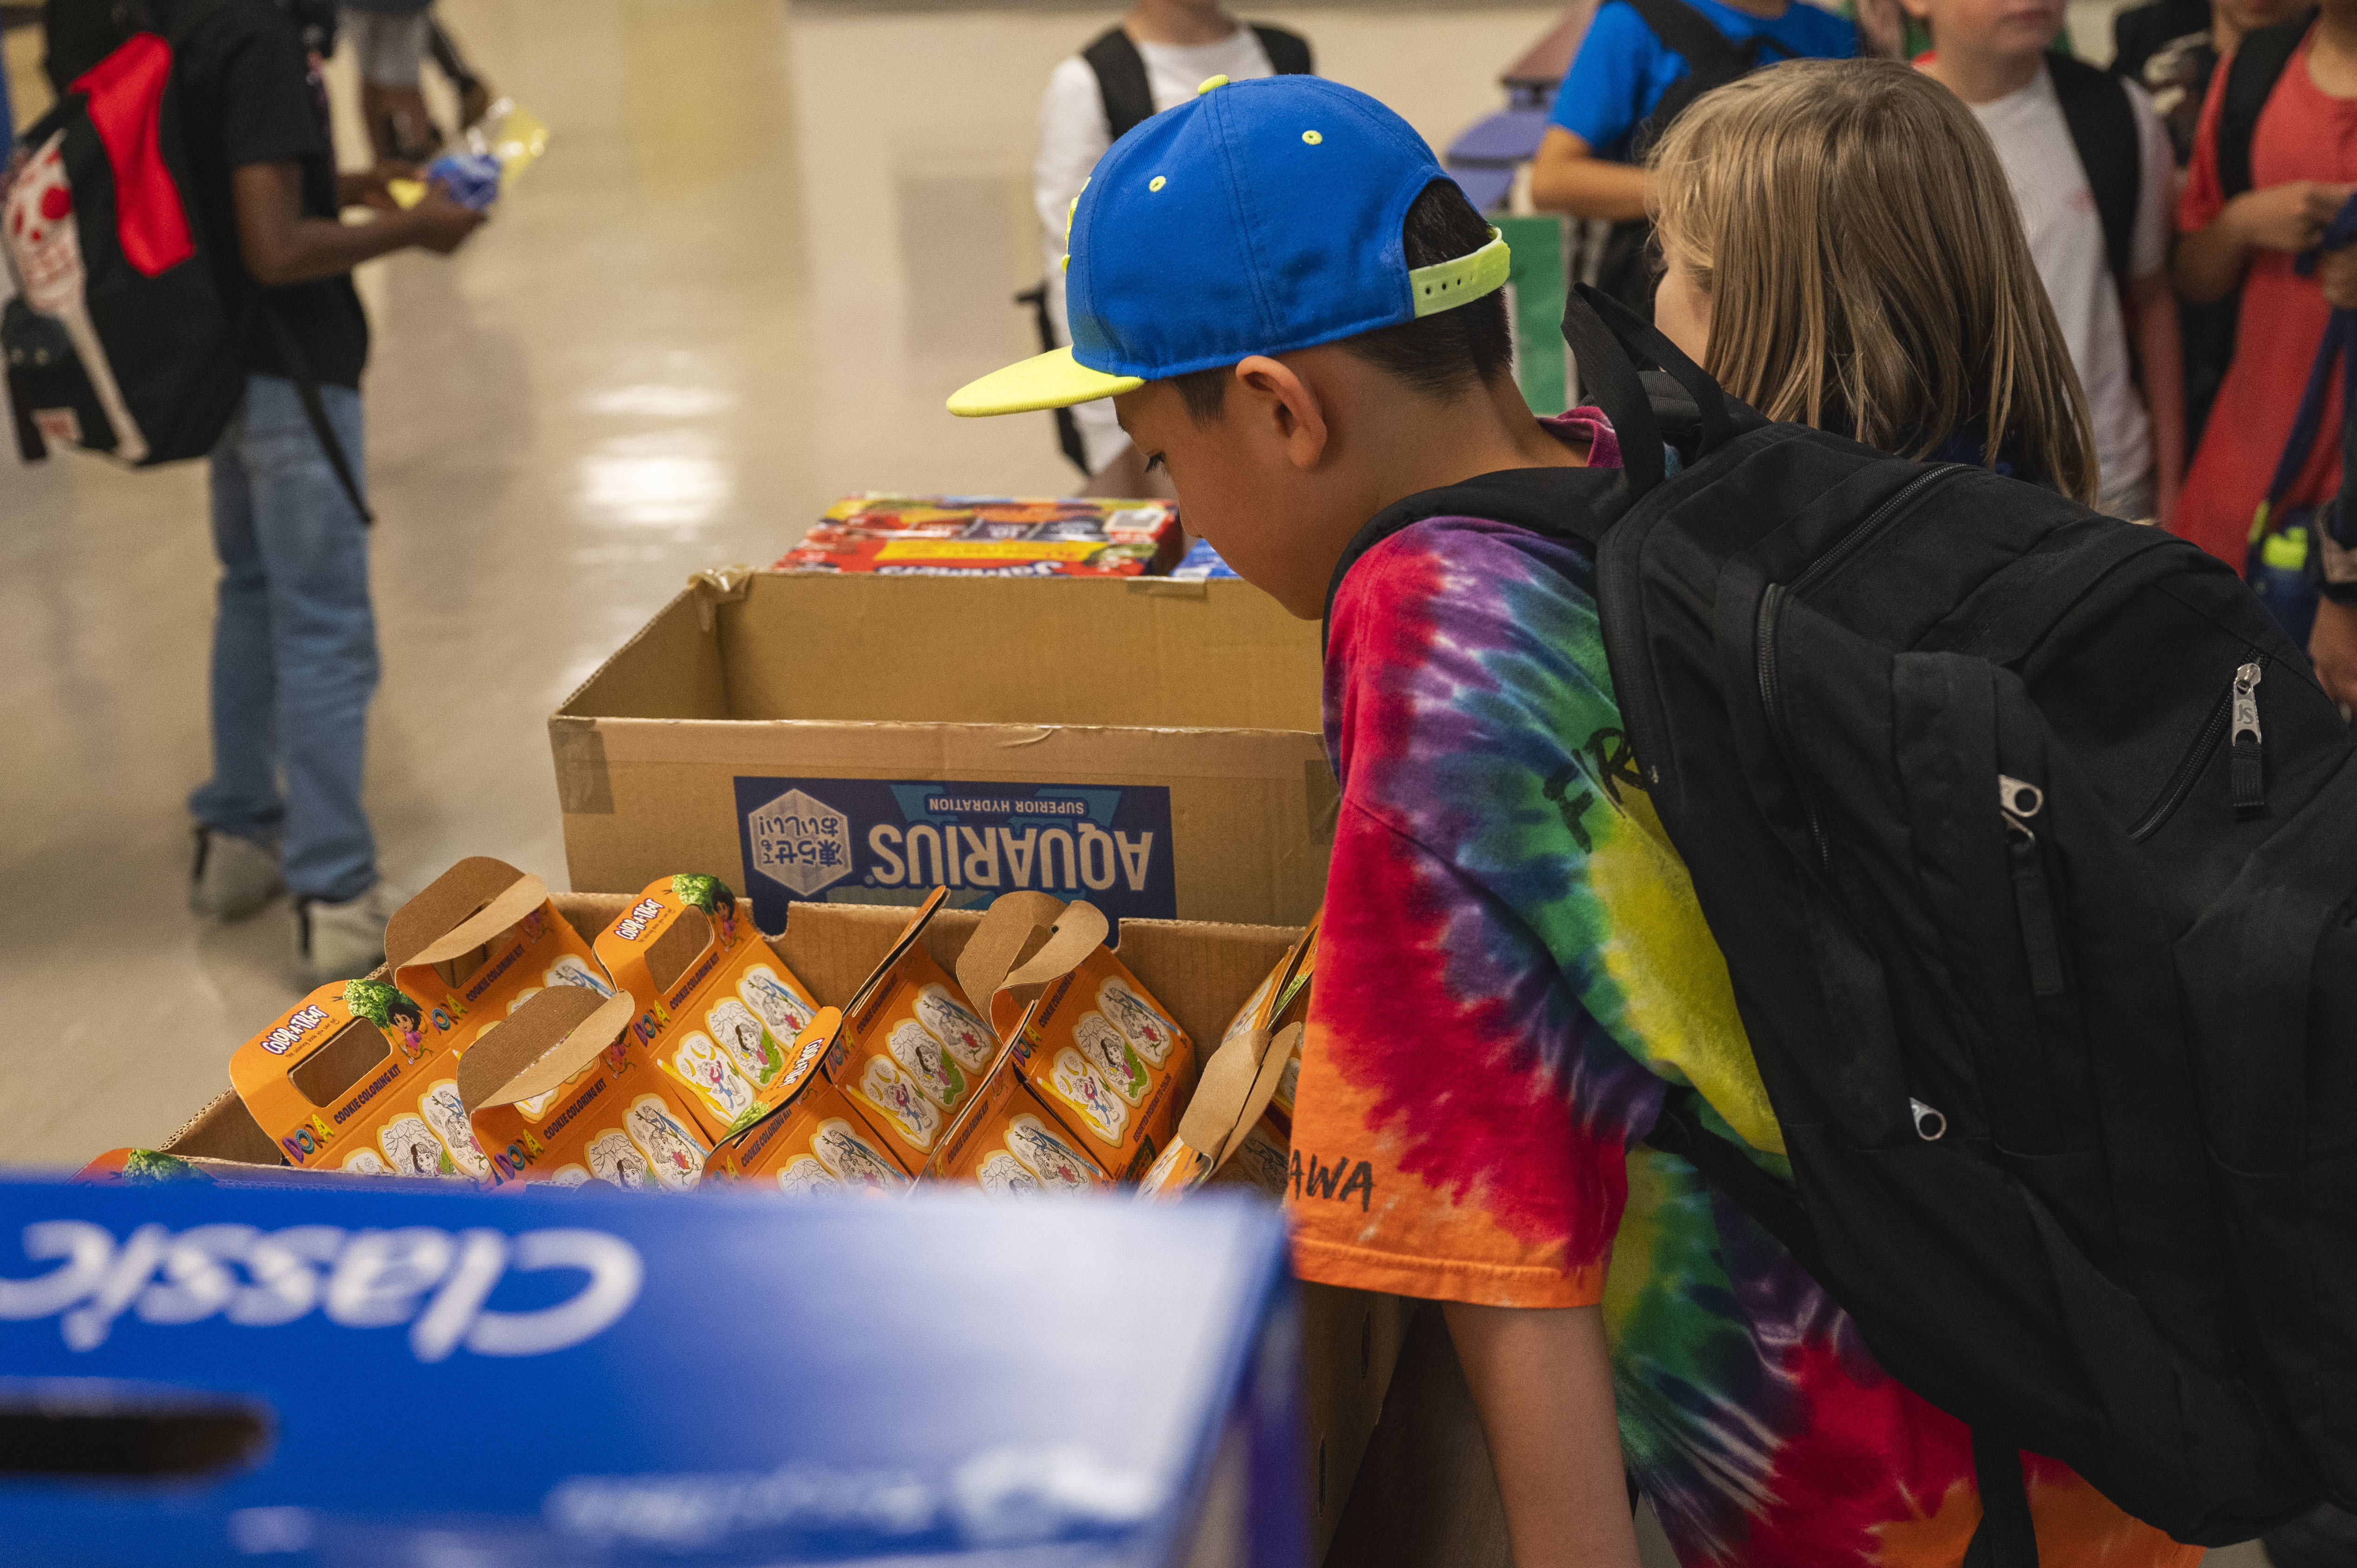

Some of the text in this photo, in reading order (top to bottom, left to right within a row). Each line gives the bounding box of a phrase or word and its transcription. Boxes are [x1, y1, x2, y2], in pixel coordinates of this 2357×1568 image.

[929, 798, 1084, 815] SUPERIOR HYDRATION
[868, 822, 1153, 891] AQUARIUS
[466, 978, 491, 1002] COOKIE
[487, 953, 517, 983] COLORING
[670, 951, 719, 1010] COOKIE COLORING KIT
[632, 1000, 671, 1048] DORA
[1039, 1002, 1055, 1028] COOKIE
[334, 1063, 401, 1125] COOKIE COLORING KIT
[544, 1077, 606, 1140] COOKIE COLORING KIT
[282, 1114, 335, 1163] DORA
[494, 1129, 545, 1180] DORA
[741, 1140, 761, 1168] COOKIE
[759, 1116, 785, 1147] COLORING
[948, 1136, 963, 1165] COOKIE
[962, 1109, 982, 1143] COLORING
[0, 1219, 645, 1363] Classic
